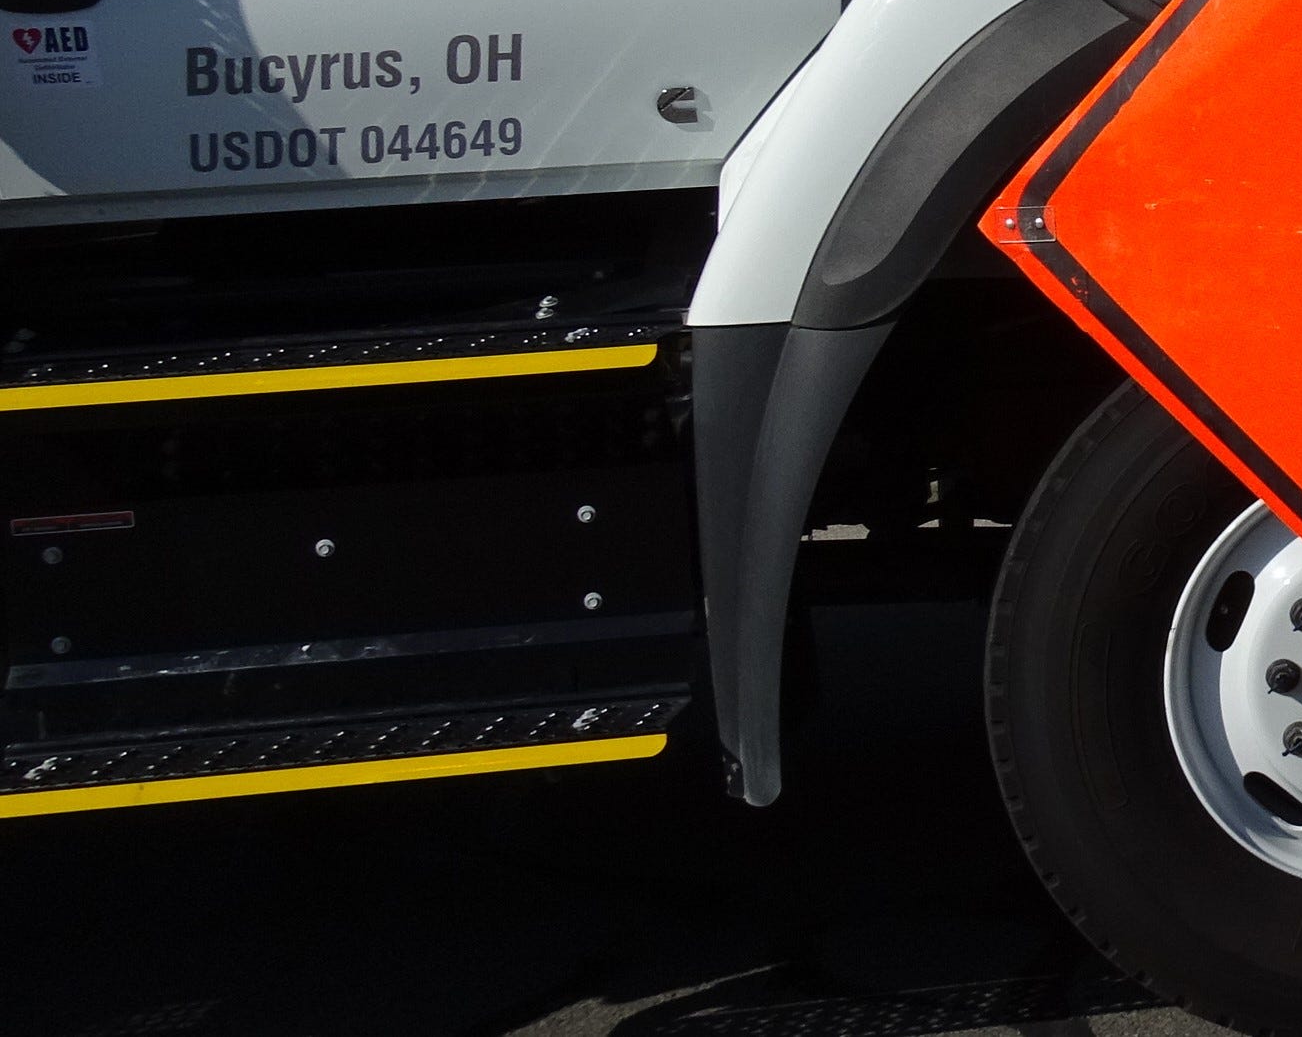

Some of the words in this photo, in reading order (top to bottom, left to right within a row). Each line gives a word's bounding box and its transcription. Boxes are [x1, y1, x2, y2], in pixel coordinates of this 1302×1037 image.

[45, 26, 89, 53] AED
[32, 72, 82, 84] INSIDE
[186, 47, 421, 103] Bucyrus,
[446, 33, 522, 84] OH
[189, 127, 345, 171] USDOT
[360, 117, 522, 164] 044649
